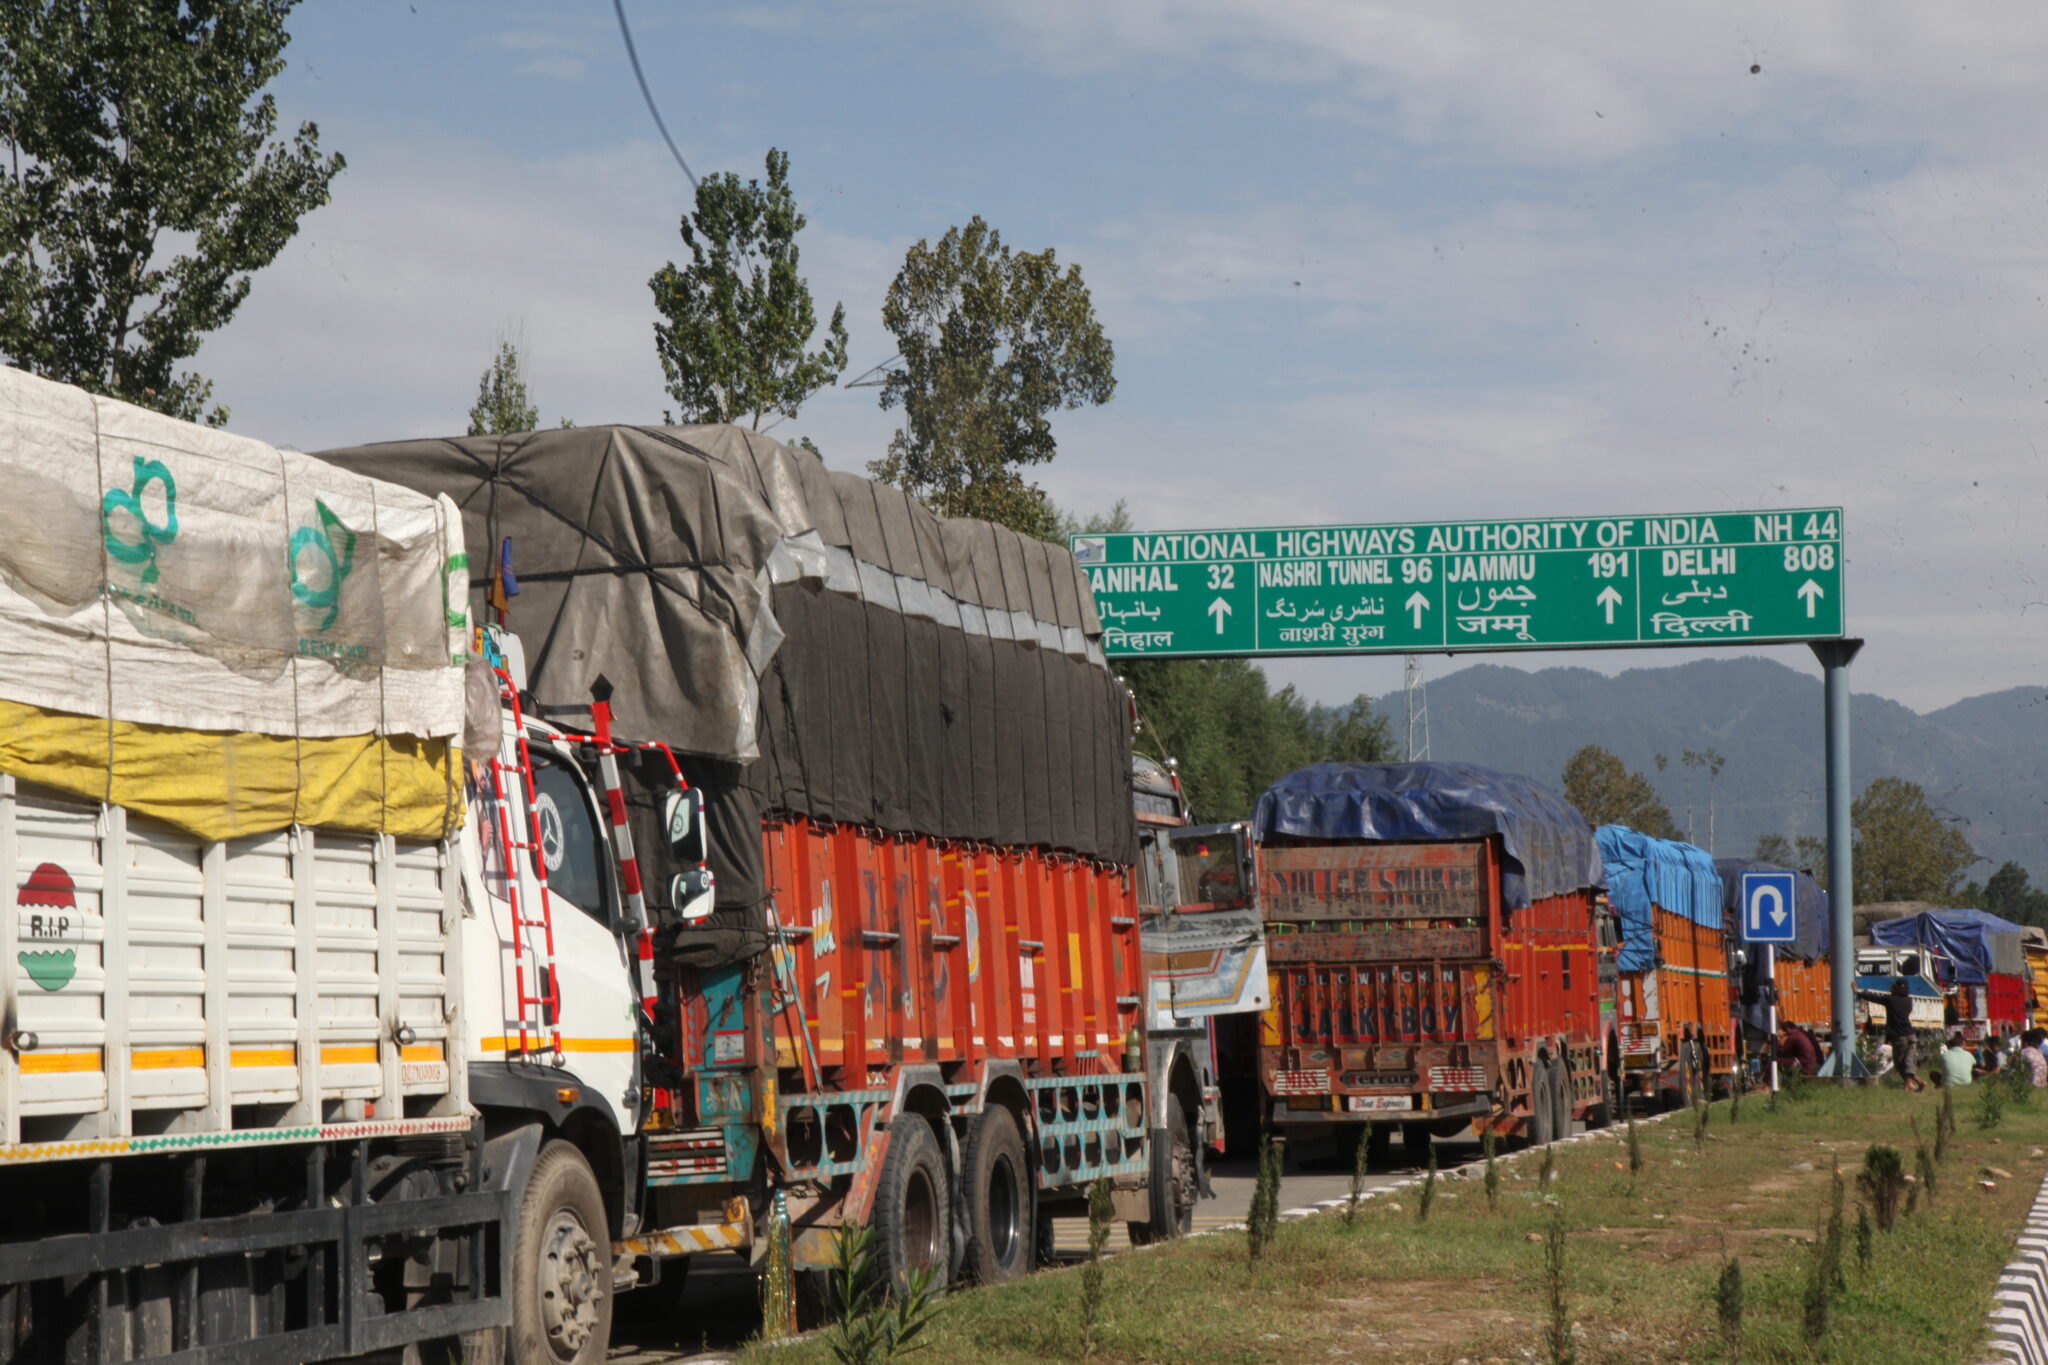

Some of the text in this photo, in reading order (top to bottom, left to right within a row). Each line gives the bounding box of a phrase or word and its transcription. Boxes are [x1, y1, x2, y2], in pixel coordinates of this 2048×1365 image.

[1132, 513, 1838, 561] NATIONAL HIGHWAYS AUTHORITY OF INDIA NH 44
[1260, 558, 1433, 588] NASHRI TUNNEL 96
[1447, 551, 1629, 583] JAMMU 191
[1662, 544, 1835, 576] DELHI 808
[1082, 564, 1235, 593] ANIHAL 32
[1279, 622, 1386, 646] नाशरी सुरंग
[1455, 615, 1537, 642] जम्मू
[1650, 609, 1754, 637] दिल्ली
[1103, 626, 1175, 651] निहाल
[1285, 1071, 1319, 1089] MISS
[1350, 1073, 1416, 1085] Ferrari
